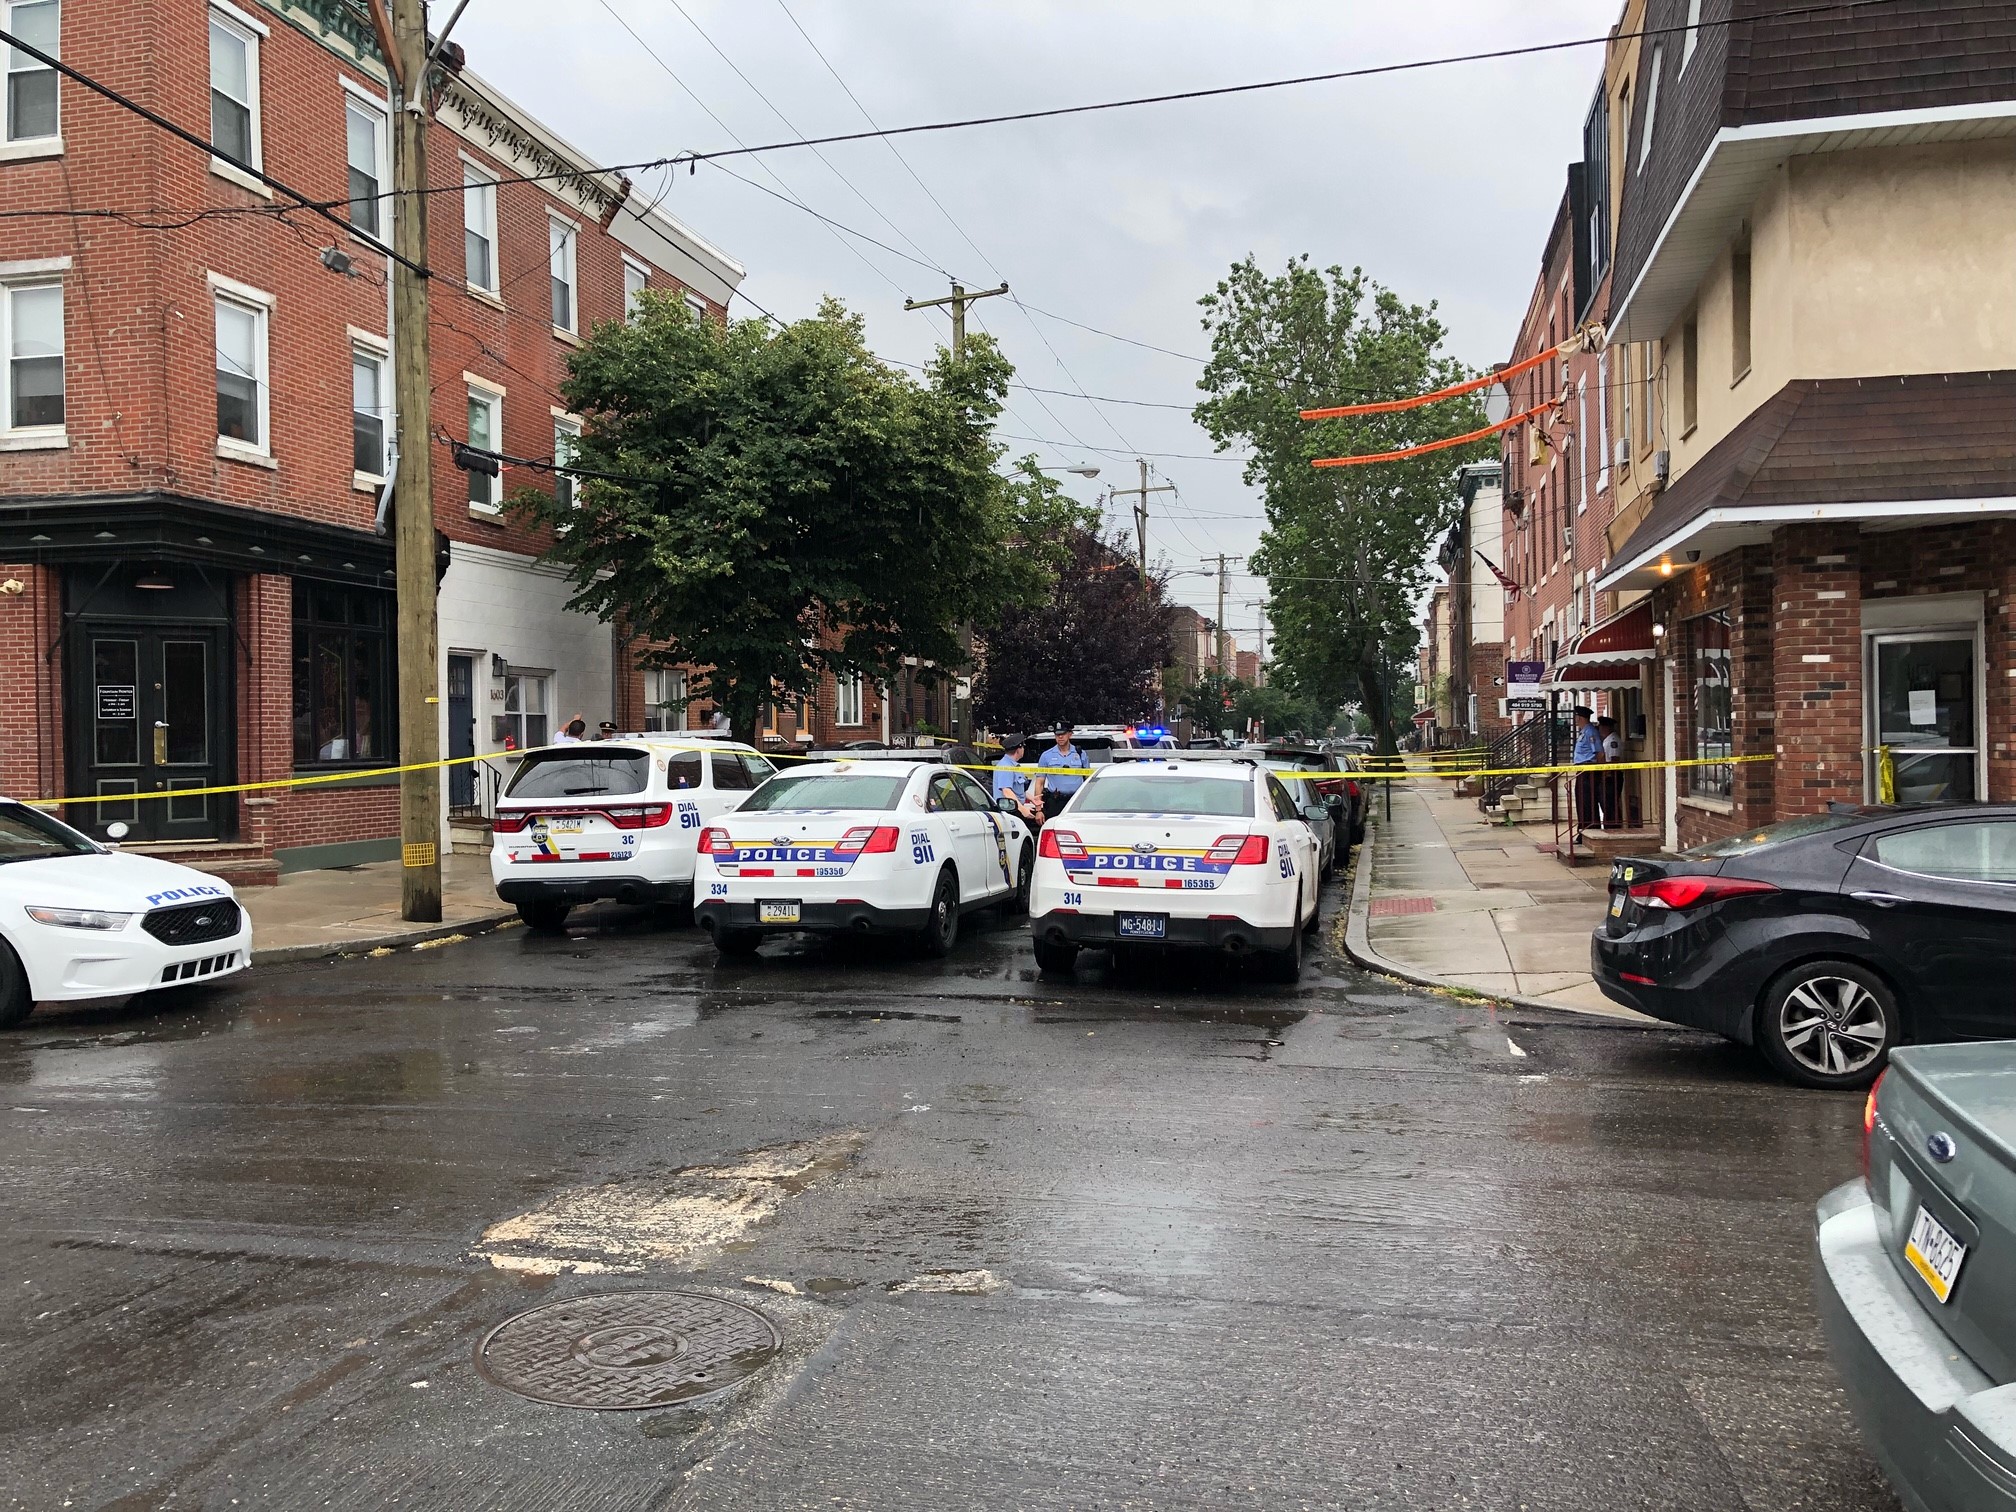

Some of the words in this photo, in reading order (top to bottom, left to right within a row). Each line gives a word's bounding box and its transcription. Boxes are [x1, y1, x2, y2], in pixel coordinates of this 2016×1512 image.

[678, 802, 698, 812] DIAL
[680, 812, 701, 829] 911
[622, 835, 634, 845] 3C
[911, 832, 931, 845] DIAL
[739, 849, 827, 861] POLICE
[913, 845, 935, 865] 911
[1094, 855, 1196, 871] POLICE
[1280, 856, 1295, 878] 911
[711, 884, 727, 895] 334
[1184, 879, 1215, 888] 165365
[145, 886, 226, 906] POLICE
[1064, 893, 1082, 906] 314
